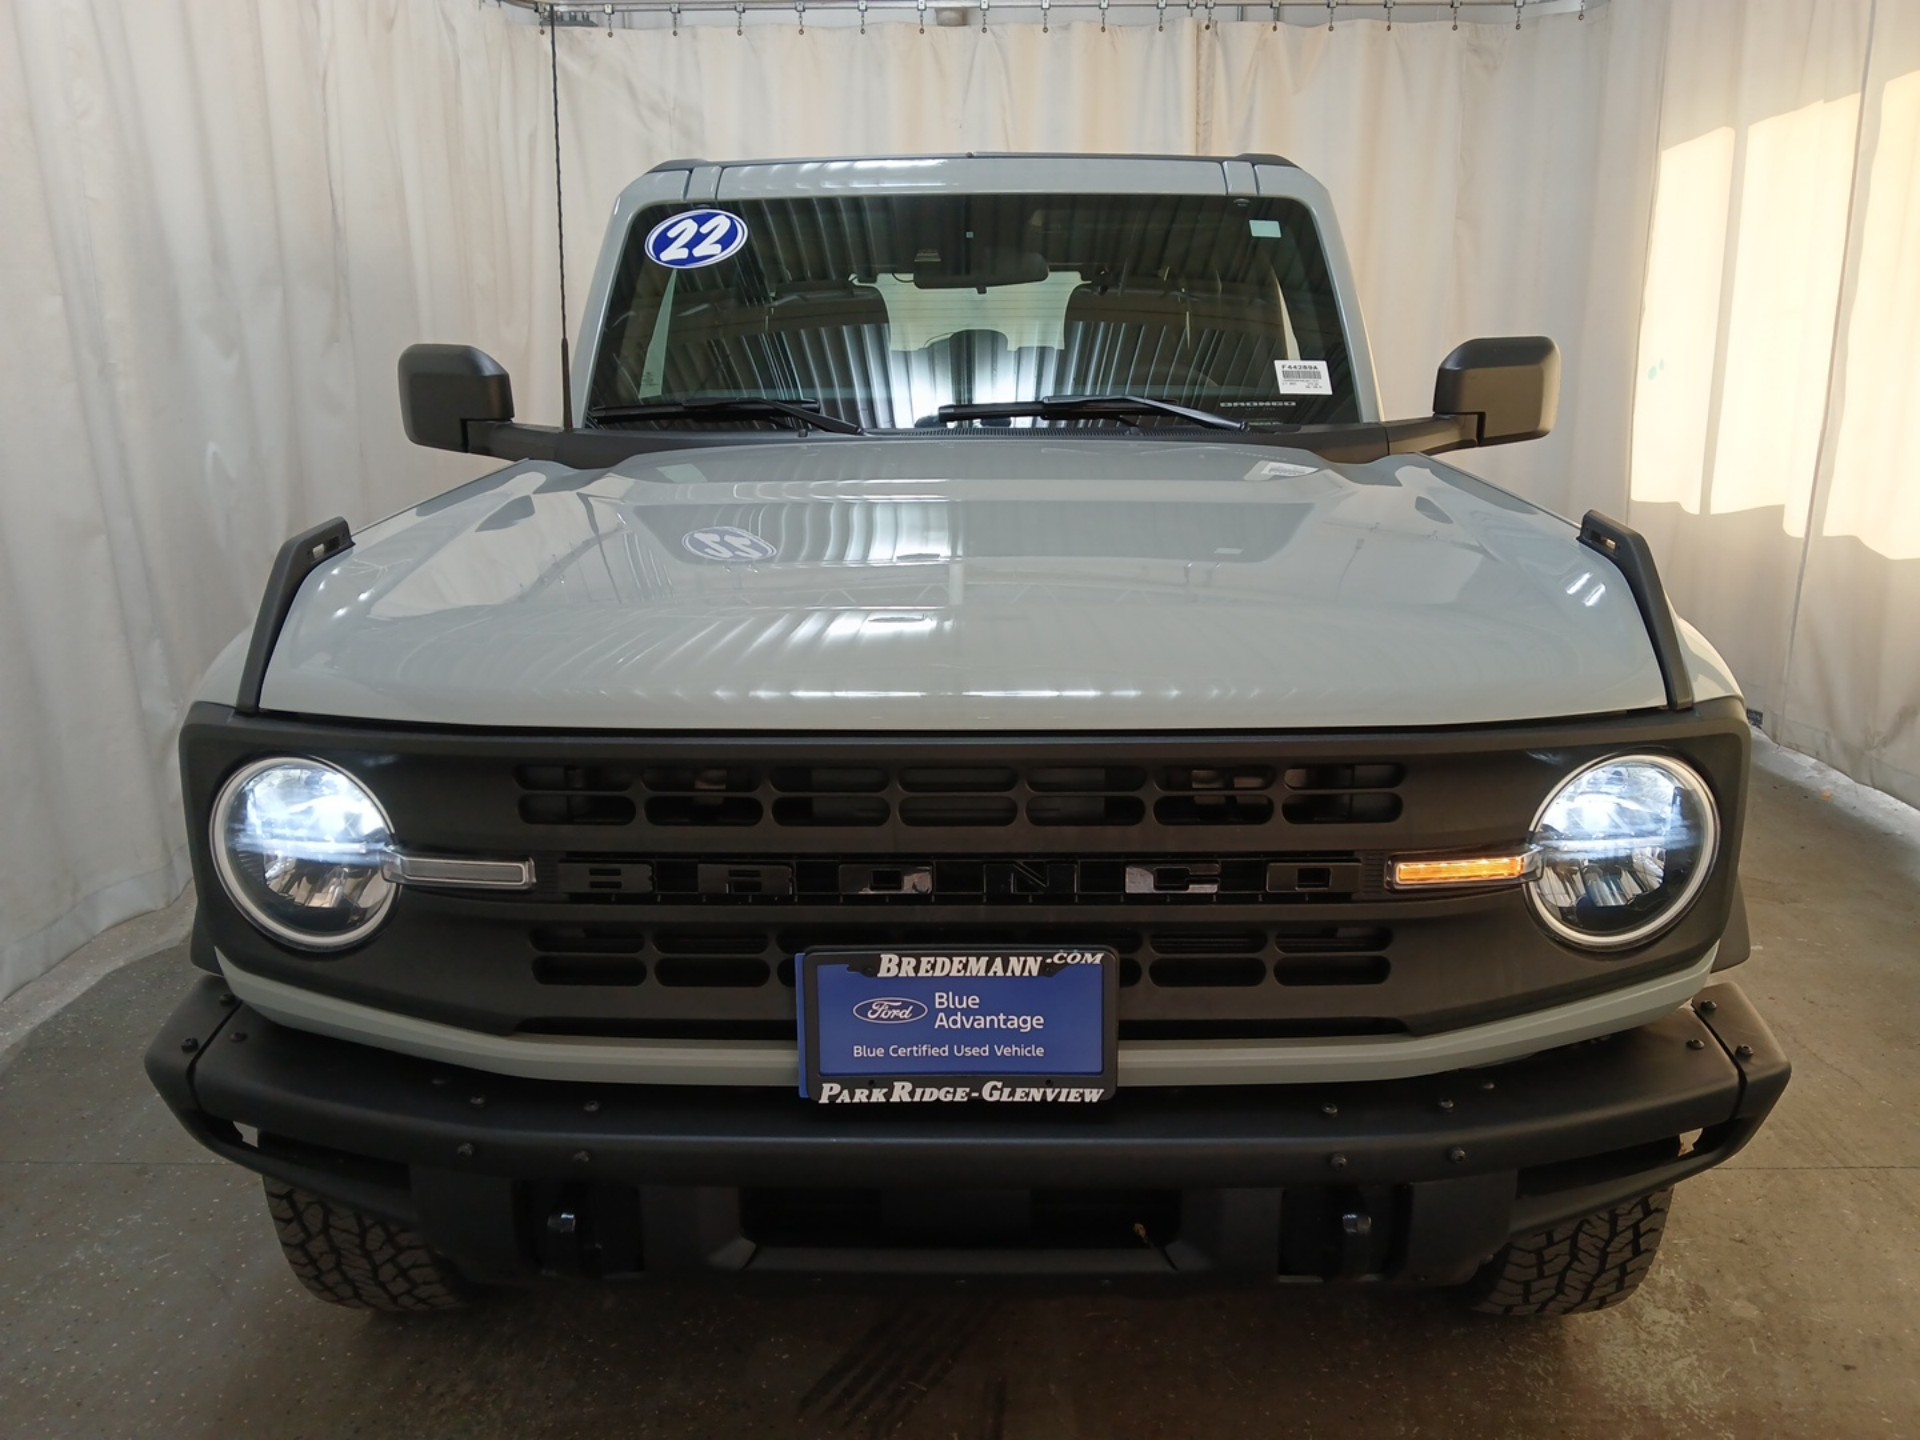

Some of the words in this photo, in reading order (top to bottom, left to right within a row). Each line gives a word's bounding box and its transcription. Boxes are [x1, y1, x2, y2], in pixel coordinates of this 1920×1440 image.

[660, 214, 731, 261] 22
[559, 862, 1361, 894] BRONCO
[934, 992, 980, 1009] Blue
[867, 1001, 912, 1020] Ford
[934, 1012, 1045, 1032] Advantage
[853, 1045, 885, 1057] Blue
[889, 1045, 949, 1057] Certified
[953, 1045, 989, 1057] Used
[994, 1045, 1045, 1057] Vehicle
